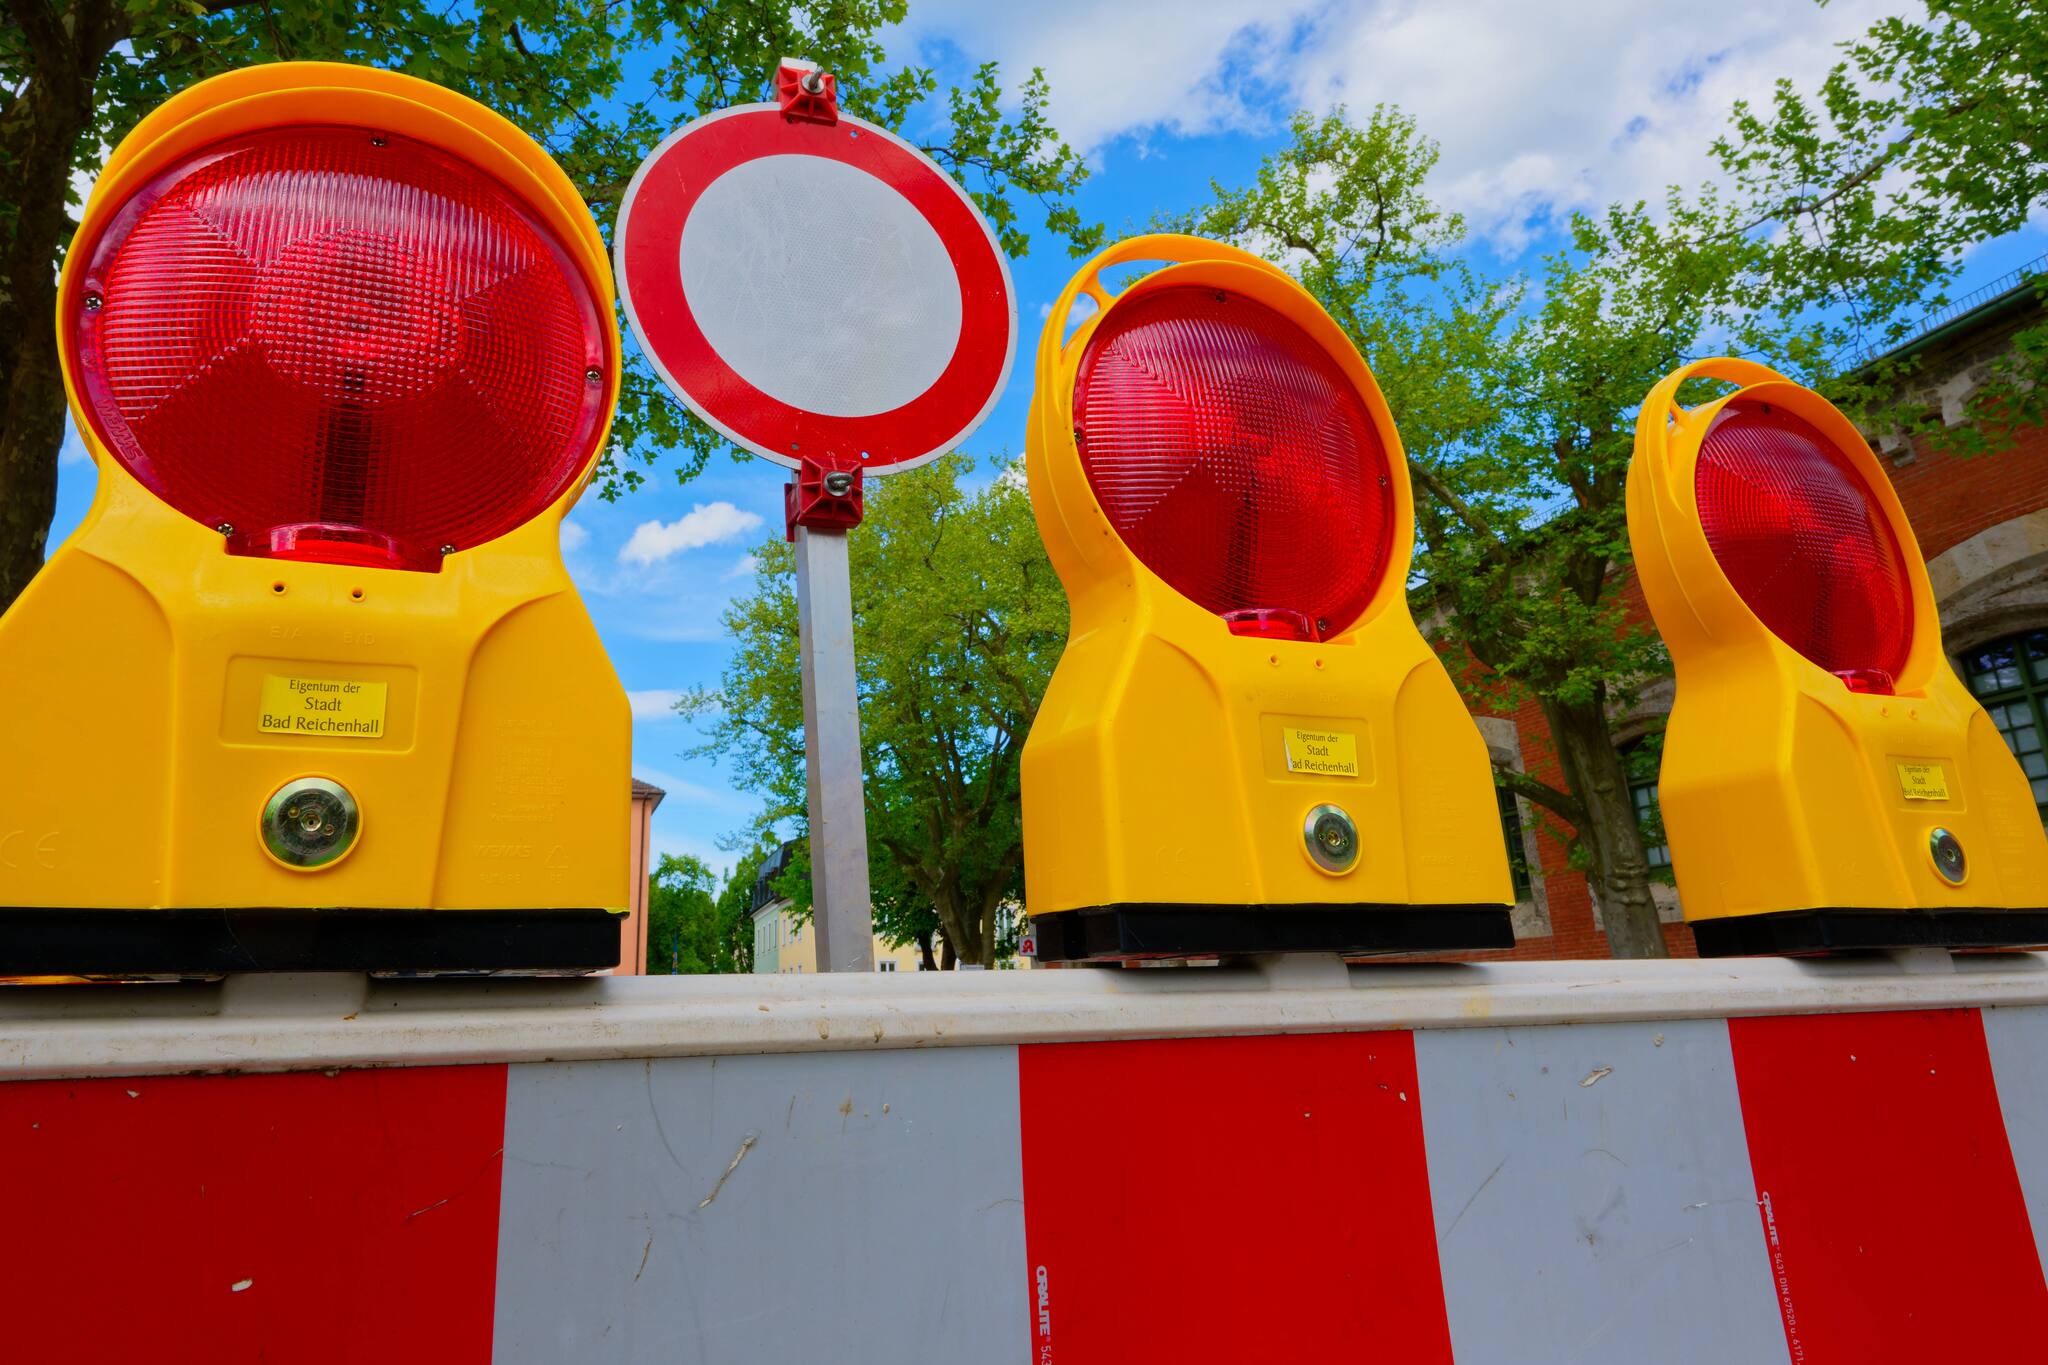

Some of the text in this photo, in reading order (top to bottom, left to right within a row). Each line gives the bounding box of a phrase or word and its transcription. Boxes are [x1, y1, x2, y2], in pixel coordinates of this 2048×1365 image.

[289, 680, 361, 694] Eigentum der
[304, 697, 342, 712] Stadt
[262, 715, 379, 733] Bad Reichenhall
[1296, 731, 1338, 742] Eigentum der
[1306, 744, 1329, 756] Stadt
[1292, 759, 1355, 773] ad Reichenhall
[1775, 1252, 1785, 1275] 5431
[1780, 1277, 1790, 1295] DIN
[1784, 1297, 1796, 1326] 67520
